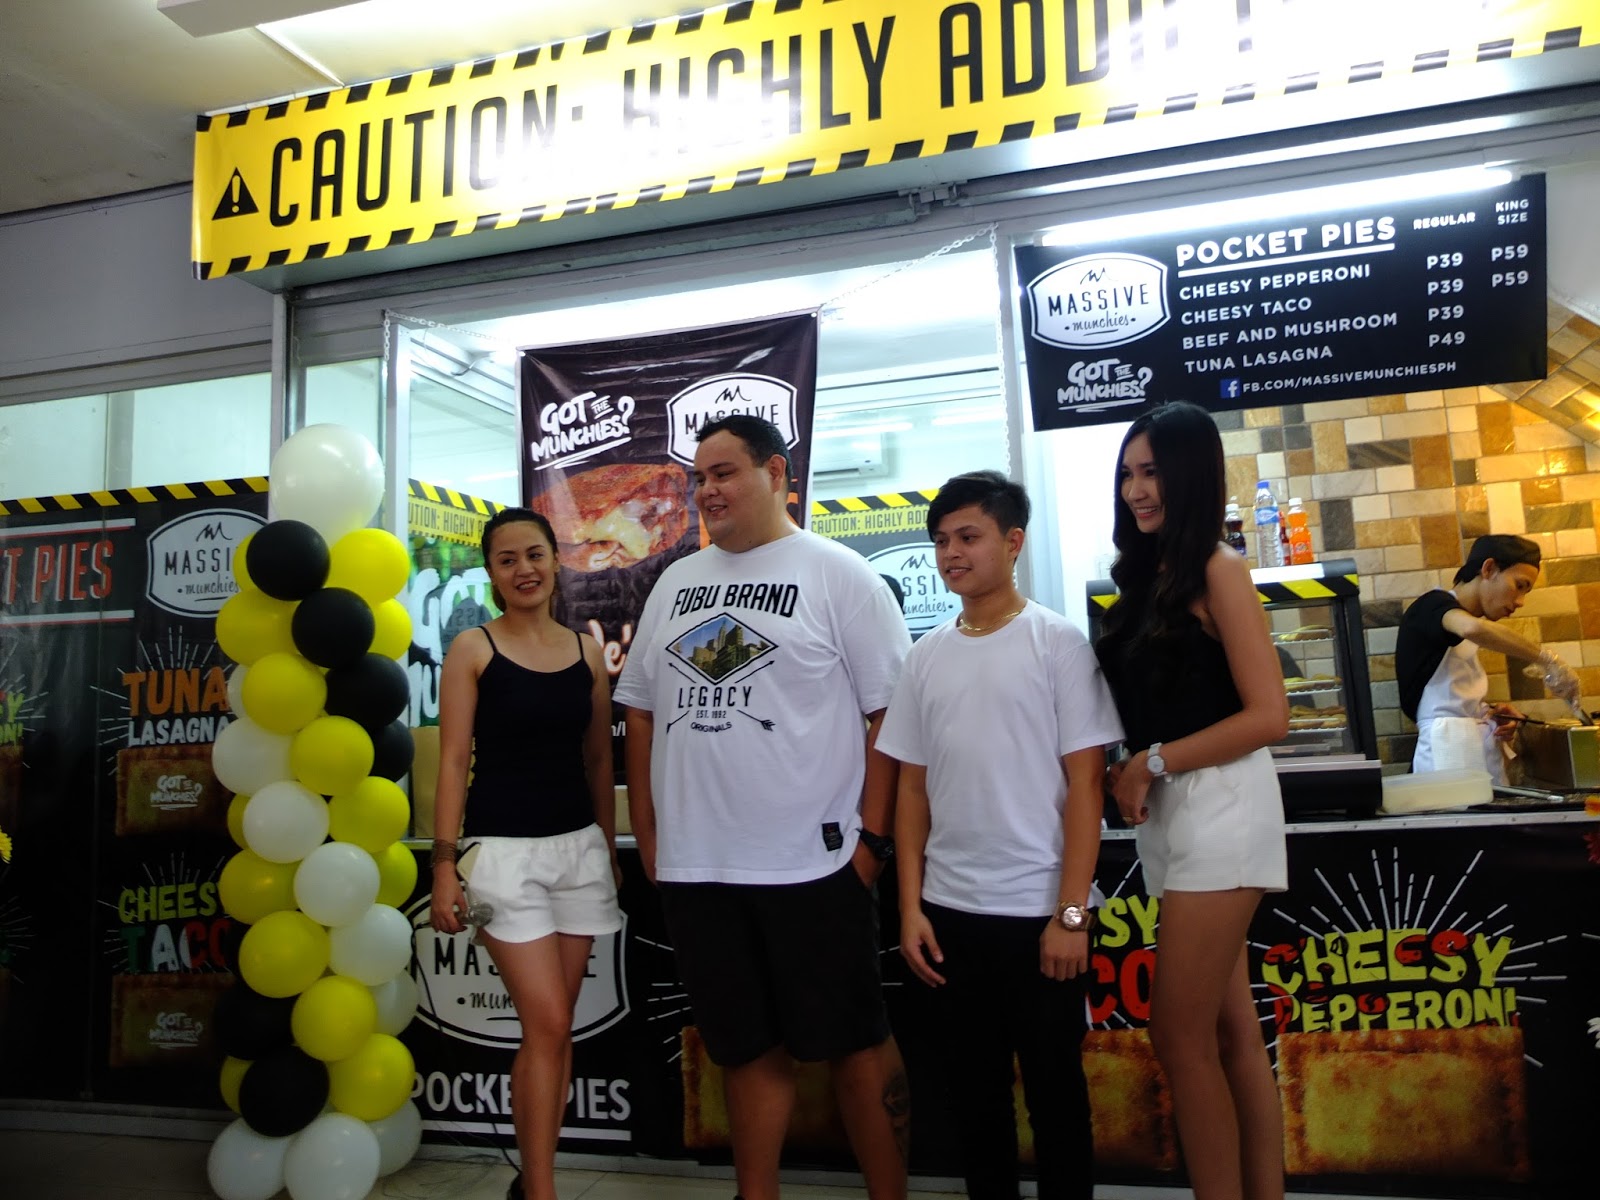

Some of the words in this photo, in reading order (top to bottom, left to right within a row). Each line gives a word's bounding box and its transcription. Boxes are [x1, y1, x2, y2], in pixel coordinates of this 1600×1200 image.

[1495, 198, 1529, 213] KING
[1497, 211, 1528, 226] SIZE
[1176, 228, 1308, 268] POCKET
[1321, 216, 1396, 248] PIES
[1413, 212, 1476, 231] REGULAR
[1426, 252, 1464, 270] P39
[1491, 244, 1529, 262] P59
[1178, 278, 1253, 301] CHEESY
[1259, 263, 1371, 291] PEPPERONI
[1427, 278, 1464, 296] P39
[1491, 270, 1529, 288] P59
[1047, 283, 1150, 317] MASSIVE
[1180, 304, 1254, 326] CHEESY
[1260, 297, 1312, 317] TACO
[1428, 304, 1464, 322] P39
[1072, 310, 1130, 332] munchies
[1182, 332, 1230, 350] BEEF
[1236, 326, 1277, 344] AND
[1284, 312, 1398, 338] MUSHROOM
[1428, 331, 1466, 348] P49
[1067, 358, 1121, 388] GOT
[1184, 355, 1236, 374] TUNA
[1242, 345, 1333, 368] LASAGNA
[1242, 361, 1457, 394] FB.COM/MASSIVEMUNCHIESPH
[540, 391, 597, 435] GOT
[591, 399, 611, 415] THE
[685, 403, 780, 435] MAVE
[443, 510, 475, 538] HIGHLY
[865, 511, 903, 530] HIGHLY
[32, 540, 114, 604] PIES
[164, 546, 239, 576] MASSI
[669, 584, 722, 621] FUBU
[722, 583, 799, 618] BRAND
[904, 596, 947, 615] unchies
[122, 666, 231, 718] TUNA
[677, 685, 752, 709] LEGACY
[690, 721, 733, 733] ORIGINALS
[117, 881, 219, 925] CHEES
[1261, 927, 1515, 995] CHEESY
